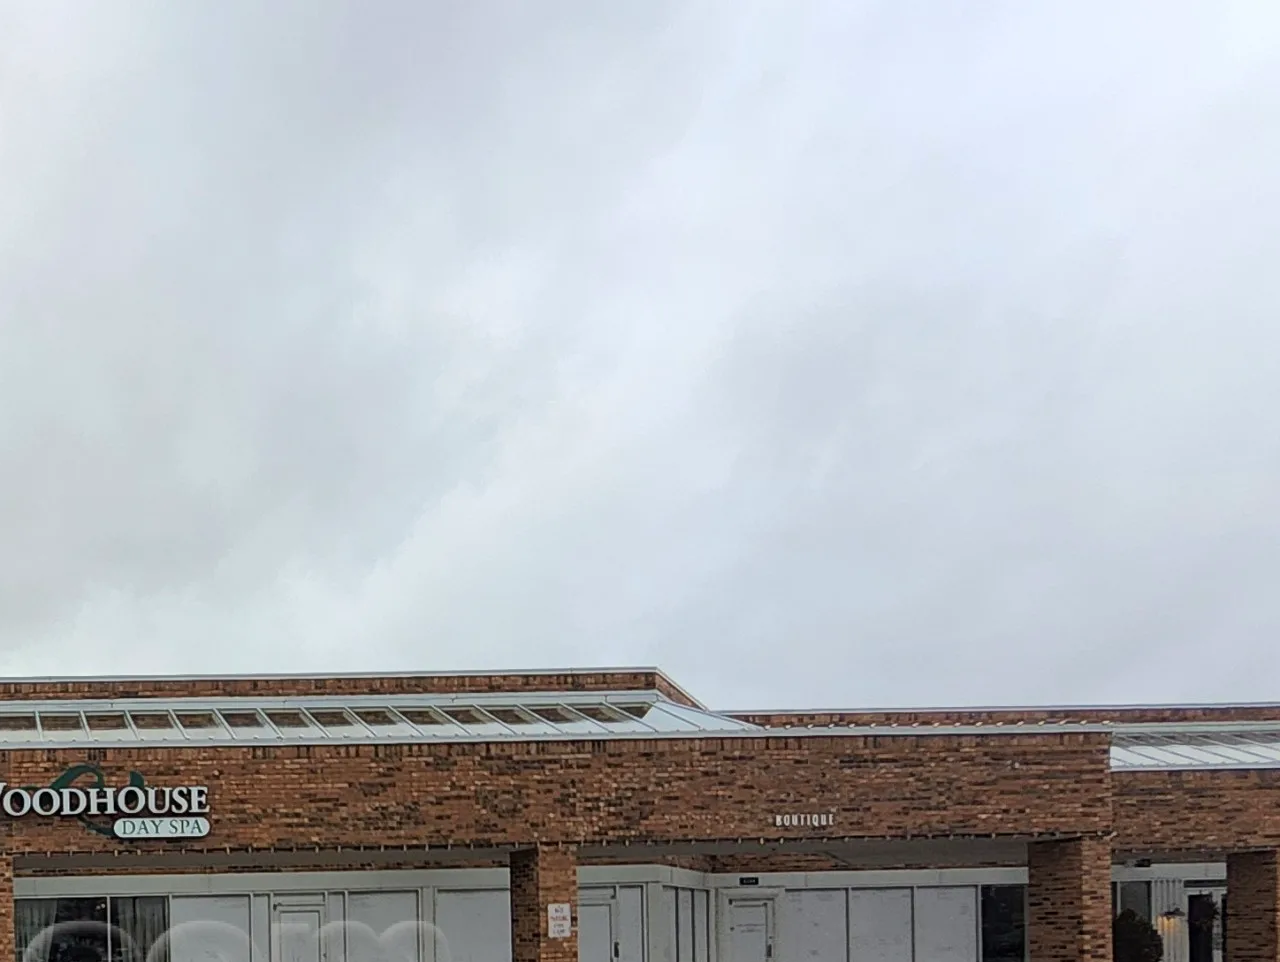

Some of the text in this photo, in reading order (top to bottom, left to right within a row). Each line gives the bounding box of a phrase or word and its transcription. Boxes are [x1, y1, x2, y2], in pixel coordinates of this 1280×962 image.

[122, 819, 203, 835] DAY SPA
[775, 813, 834, 827] BOUTIQUE
